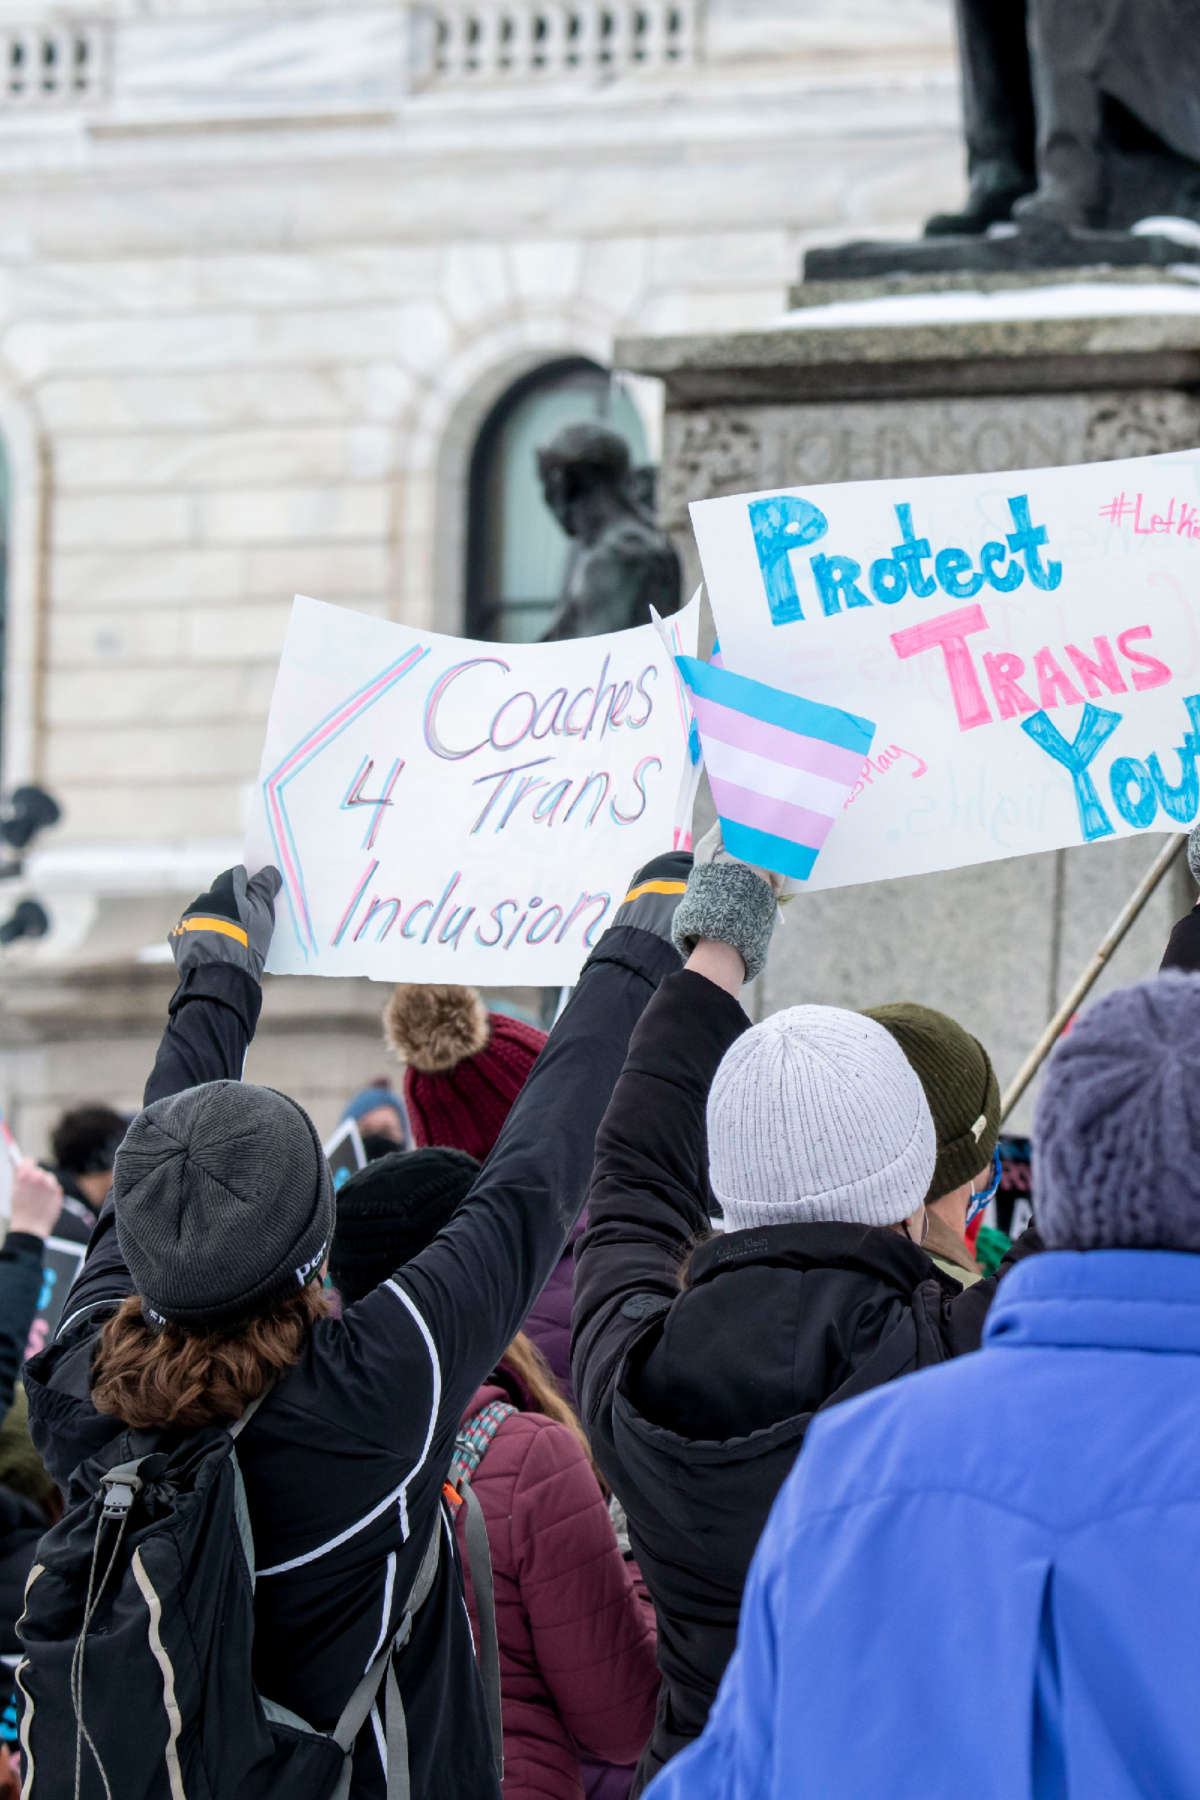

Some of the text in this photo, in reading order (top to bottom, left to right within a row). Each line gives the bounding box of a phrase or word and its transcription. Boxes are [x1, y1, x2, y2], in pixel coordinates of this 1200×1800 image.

[772, 414, 1070, 487] JOHNSON
[423, 652, 658, 761] Coaches
[890, 603, 1173, 732] TRANS
[340, 754, 663, 851] 4 Trans
[330, 858, 611, 951] Inclusion
